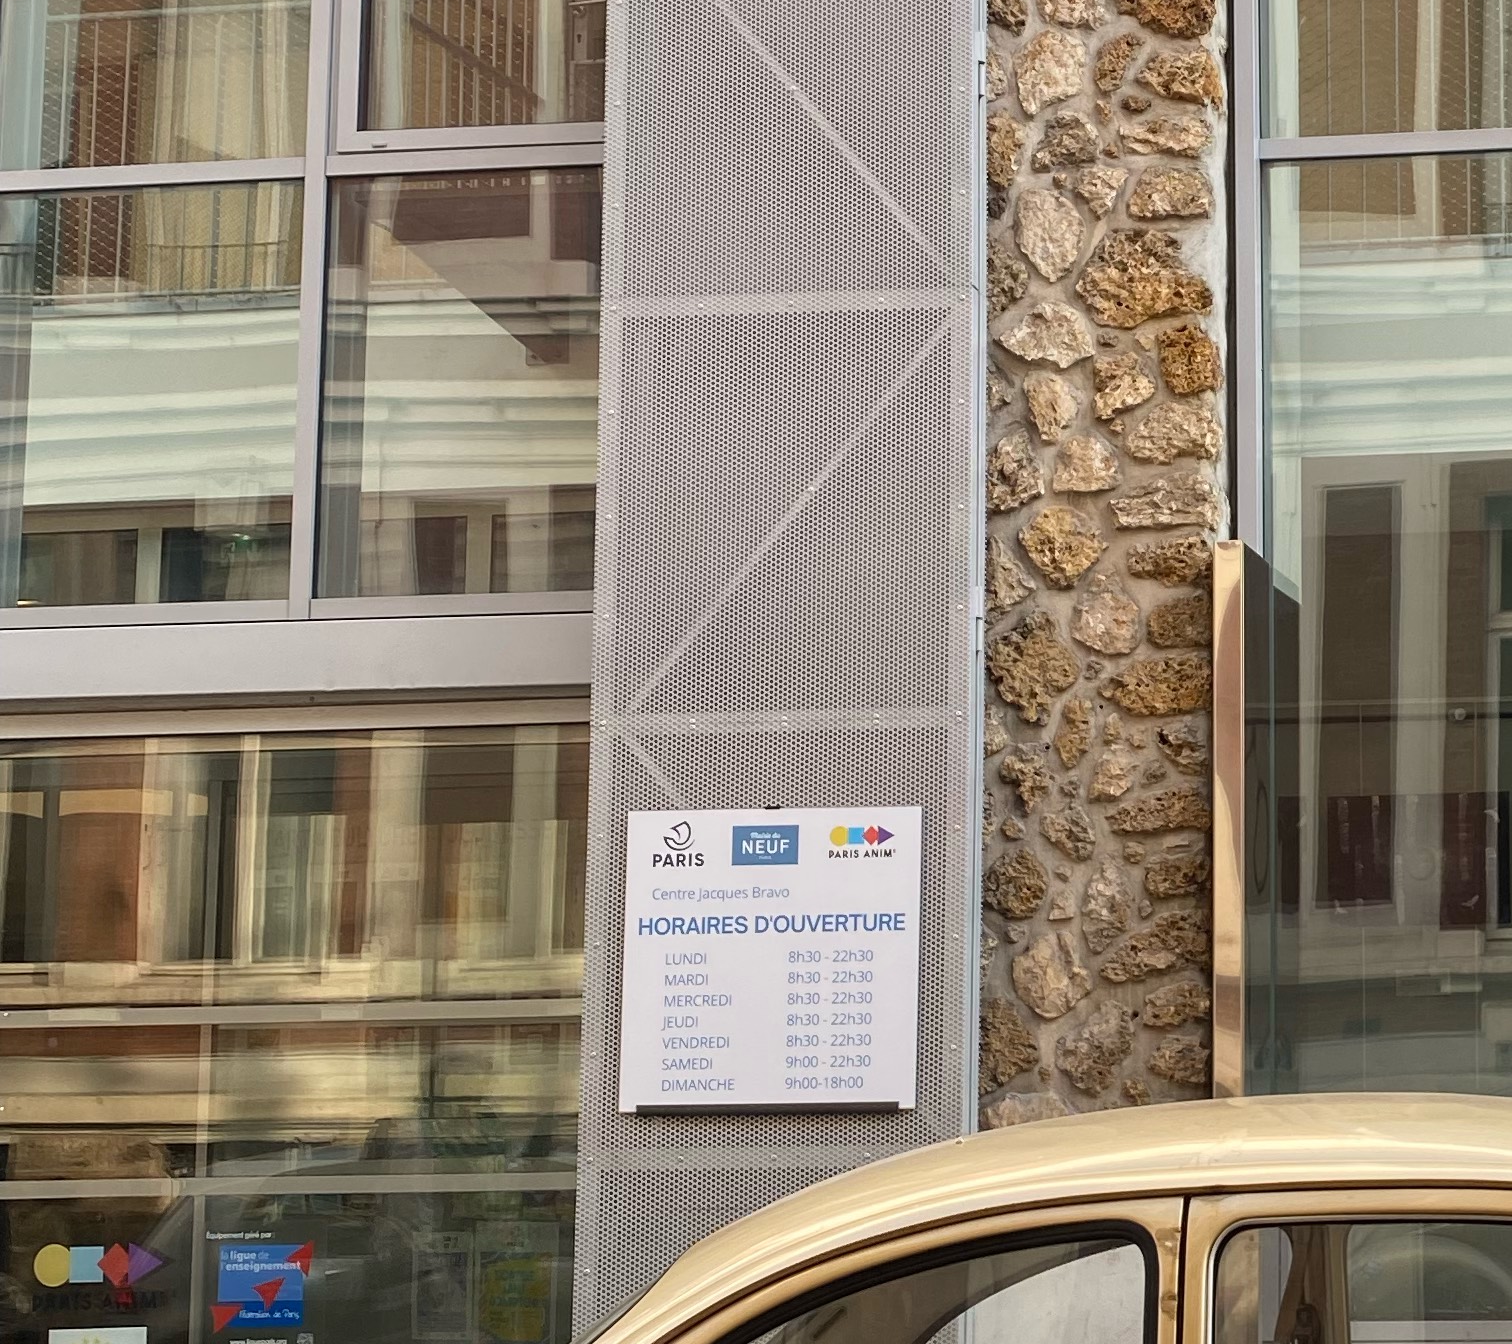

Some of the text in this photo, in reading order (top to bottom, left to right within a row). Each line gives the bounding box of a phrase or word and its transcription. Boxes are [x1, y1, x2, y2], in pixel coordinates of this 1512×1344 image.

[741, 839, 789, 855] NEUF
[828, 849, 859, 859] PARIS
[652, 852, 705, 868] PARIS
[652, 886, 790, 903] Centre Jacques Bravo
[638, 913, 906, 936] HORAIRES D'OUVERTURE
[665, 953, 707, 966] LUNDI
[788, 950, 821, 964] 8h30
[832, 949, 874, 962] 22h30
[664, 973, 709, 986] MARDI
[787, 971, 820, 984] 8h30
[831, 970, 873, 984] 22h30
[664, 994, 732, 1008] MERCREDI
[787, 992, 820, 1005] 8h30
[831, 991, 873, 1005] 22h30
[661, 1016, 699, 1030] JEUDI
[786, 1013, 819, 1026] 8h30
[830, 1012, 872, 1025] 22h30
[662, 1036, 730, 1050] VENDREDI
[786, 1034, 819, 1047] 8h30
[830, 1033, 872, 1046] 22h30
[661, 1057, 713, 1070] SAMEDI
[785, 1055, 819, 1068] 9h00
[829, 1054, 871, 1067] 22h30
[661, 1078, 736, 1091] DIMANCHE
[784, 1076, 864, 1089] 9h00-18h00
[230, 1251, 256, 1262] ligue
[258, 1251, 269, 1259] de
[221, 1261, 301, 1272] l'enseignement
